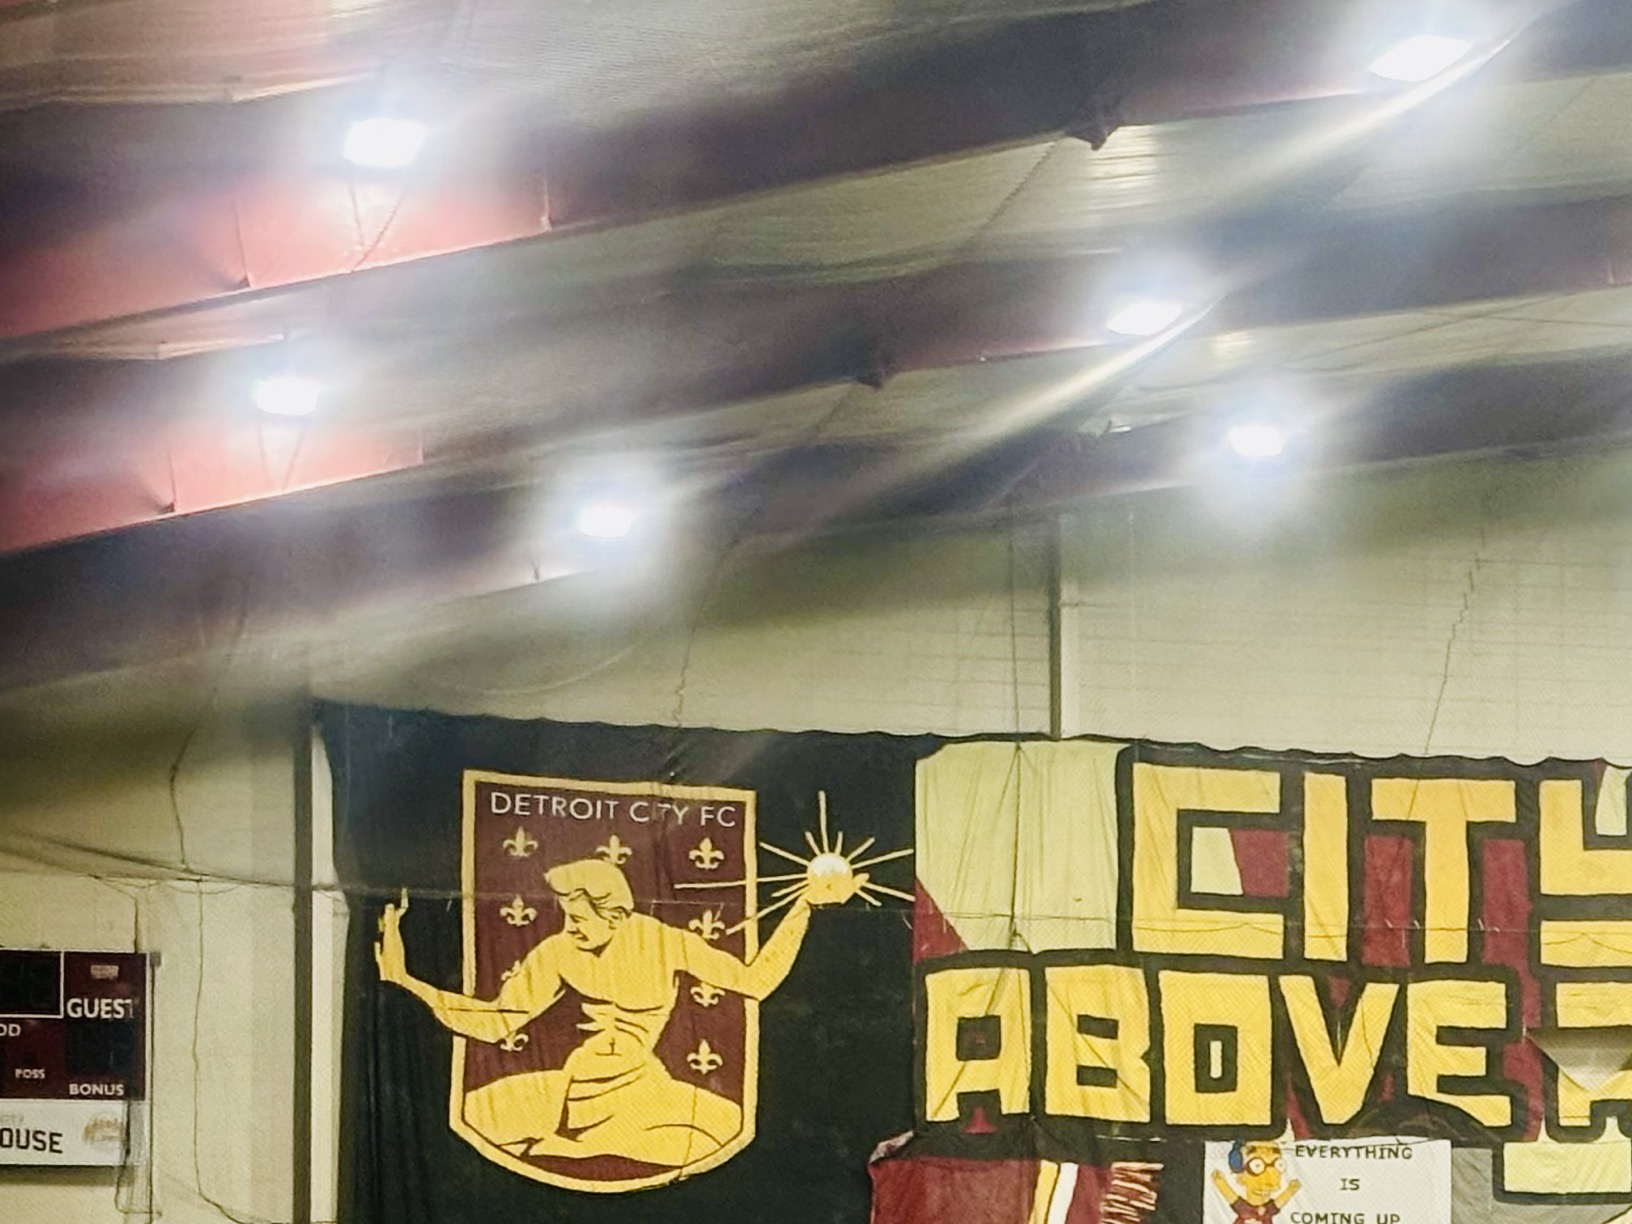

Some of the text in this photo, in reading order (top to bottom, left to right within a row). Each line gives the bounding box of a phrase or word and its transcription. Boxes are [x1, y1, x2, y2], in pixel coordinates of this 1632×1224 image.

[490, 791, 620, 821] DETROIT
[700, 805, 737, 829] FC
[66, 997, 135, 1020] GUEST
[924, 966, 1512, 1127] ABOVE
[14, 1068, 46, 1079] POSS
[69, 1082, 125, 1097] BONUS
[1294, 1143, 1413, 1162] EVERYTHING
[1339, 1178, 1360, 1192] IS
